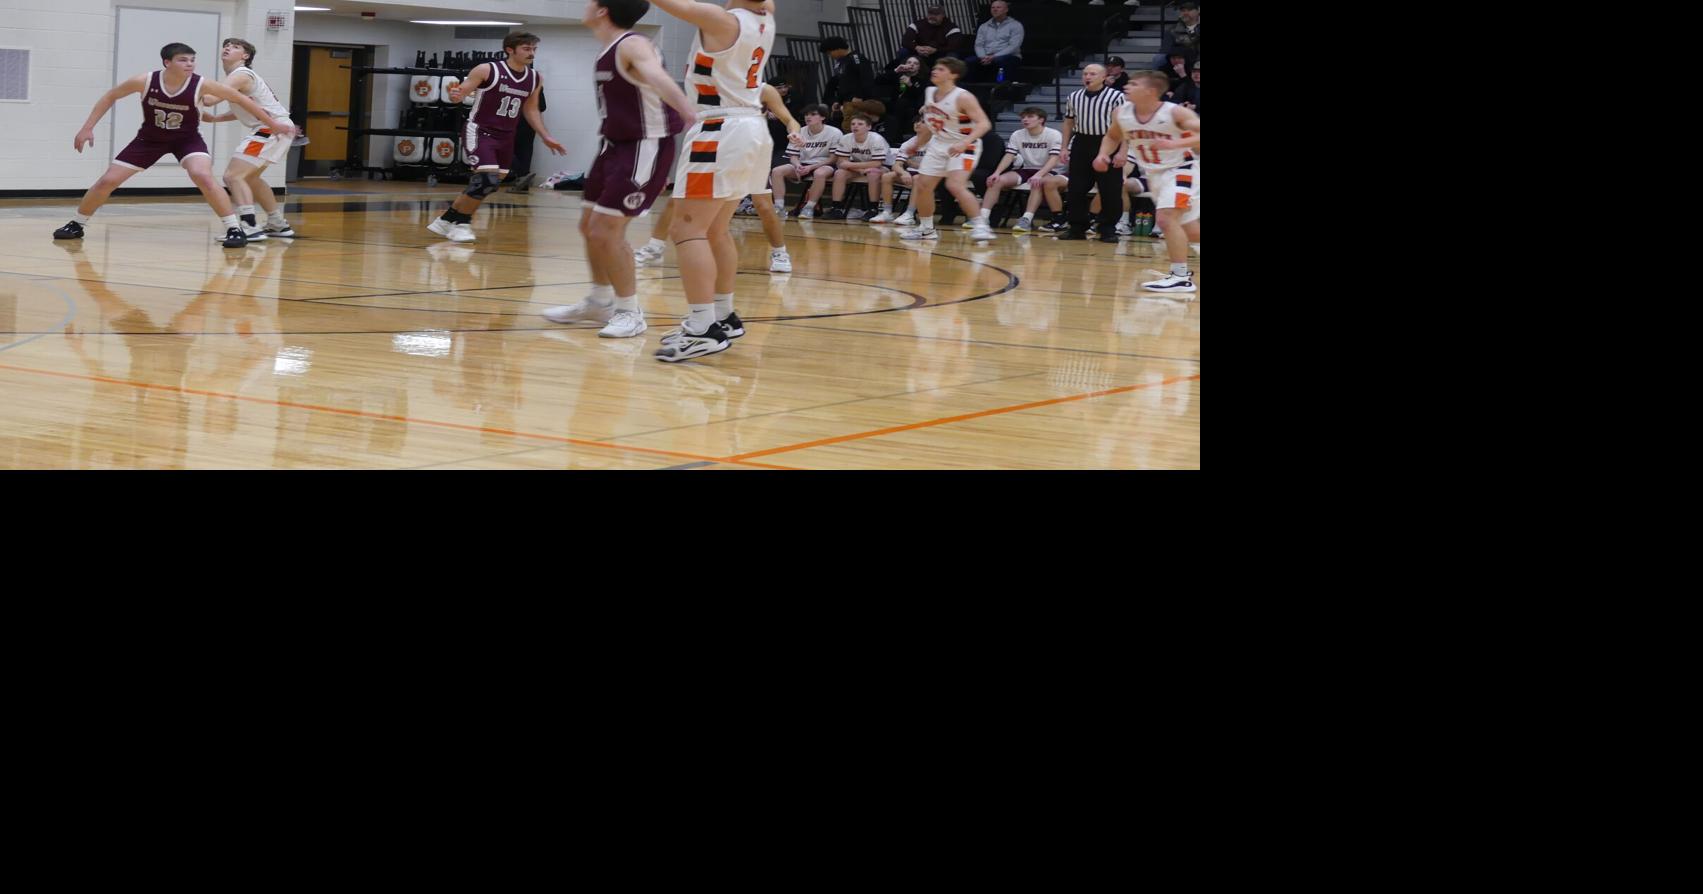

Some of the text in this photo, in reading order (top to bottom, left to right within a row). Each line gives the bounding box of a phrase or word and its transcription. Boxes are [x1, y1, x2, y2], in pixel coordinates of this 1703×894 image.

[746, 47, 765, 88] 2
[496, 96, 521, 118] 13
[153, 109, 184, 130] 22
